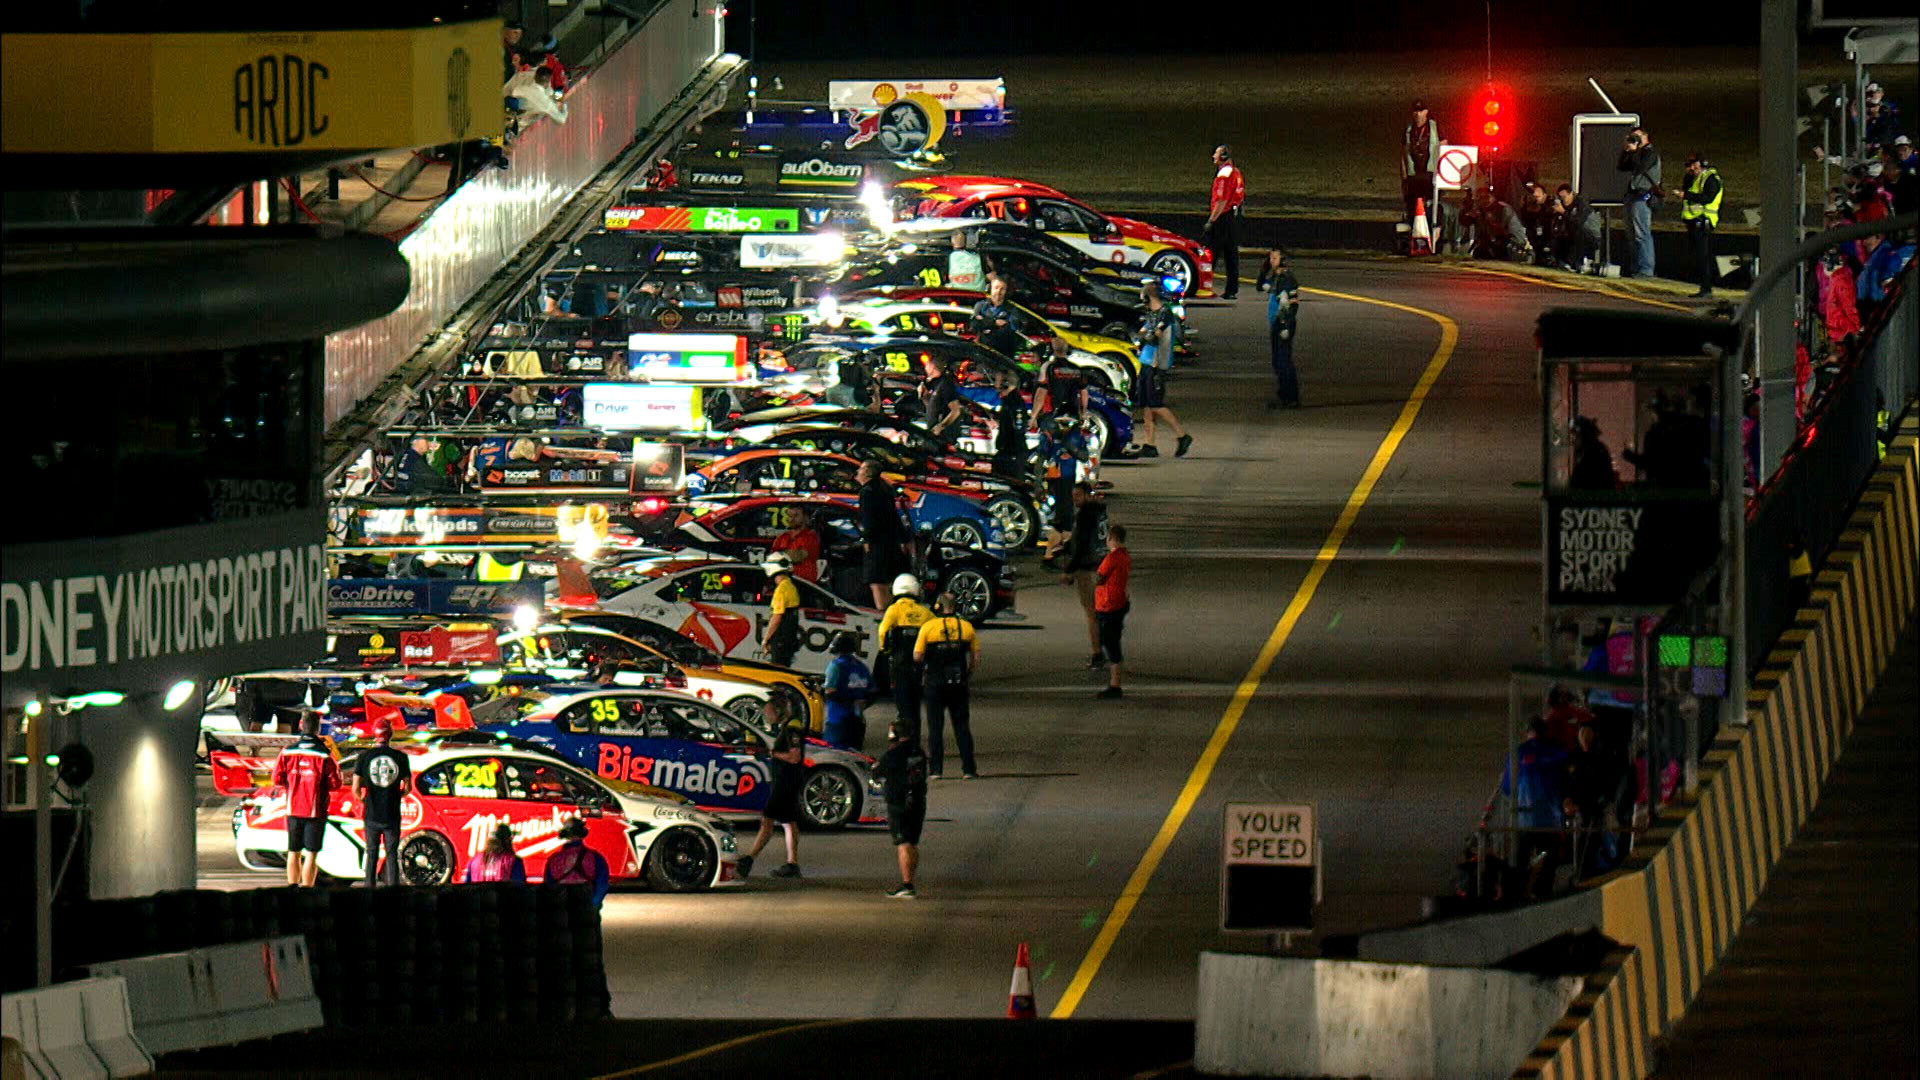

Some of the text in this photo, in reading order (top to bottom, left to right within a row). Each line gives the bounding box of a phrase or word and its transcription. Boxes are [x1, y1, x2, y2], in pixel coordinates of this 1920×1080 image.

[235, 54, 329, 147] ARDC
[692, 173, 744, 185] TEKNO
[986, 201, 1004, 218] 17
[919, 267, 941, 287] 19
[742, 287, 779, 297] Wilson
[742, 297, 787, 308] Security
[900, 314, 913, 331] 5
[885, 353, 910, 373] 56
[779, 457, 791, 478] 7
[1561, 508, 1643, 530] SYDNEY
[1560, 530, 1635, 550] MOTOR
[1561, 551, 1631, 572] SPORT
[701, 573, 722, 590] 25
[1560, 572, 1617, 592] PARK
[328, 585, 415, 601] CoolDrive
[128, 551, 276, 660] MOTORSPORT
[404, 645, 433, 658] Red
[590, 700, 620, 722] 35
[454, 763, 496, 788] 230
[597, 742, 738, 797] Bigmate
[462, 805, 584, 857] Mwauk
[1237, 814, 1301, 833] YOUR
[1232, 839, 1307, 857] SPEED
